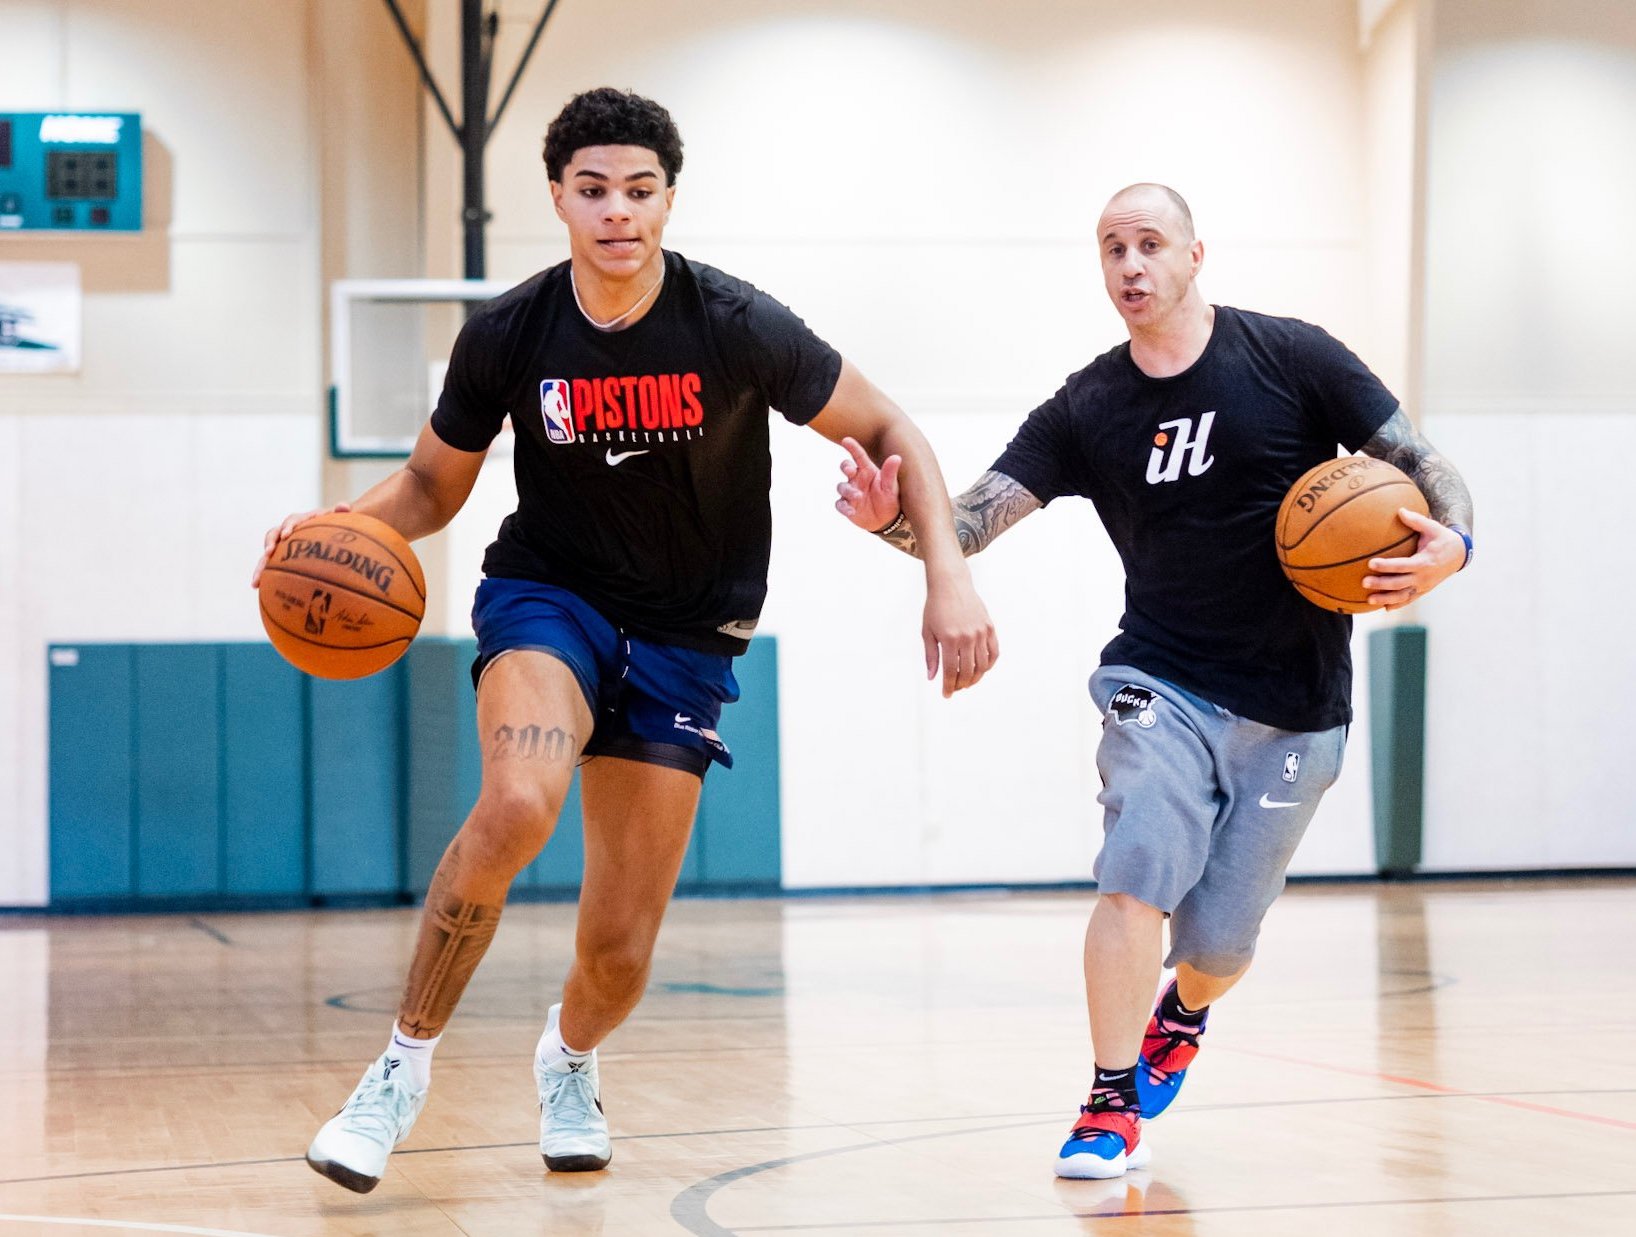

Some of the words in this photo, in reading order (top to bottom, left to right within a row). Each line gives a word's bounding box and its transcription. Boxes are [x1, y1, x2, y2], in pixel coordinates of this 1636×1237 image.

[572, 372, 704, 432] PISTONS
[281, 538, 395, 593] SPALDING
[1115, 692, 1148, 709] BUCKS
